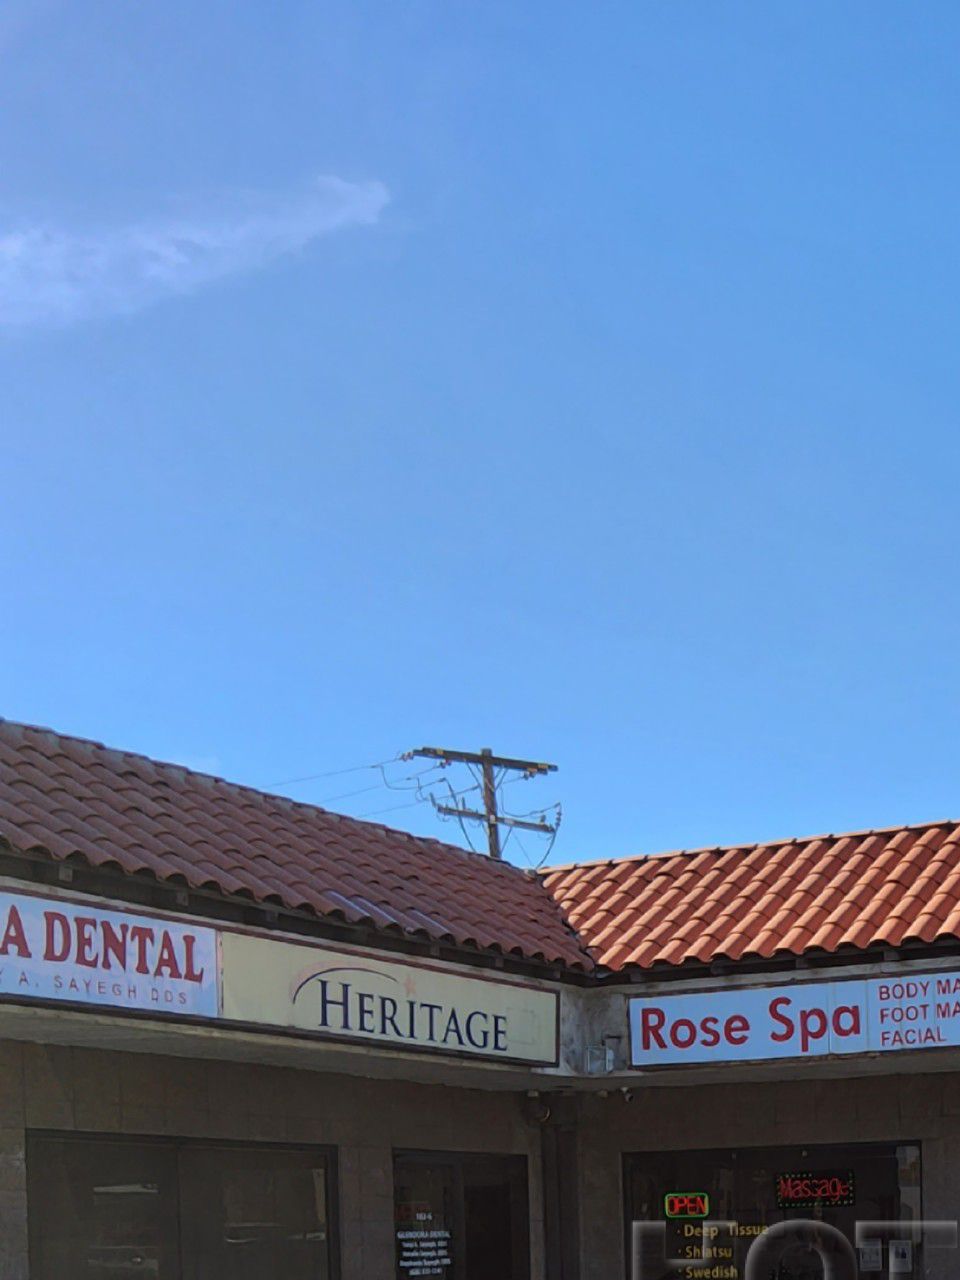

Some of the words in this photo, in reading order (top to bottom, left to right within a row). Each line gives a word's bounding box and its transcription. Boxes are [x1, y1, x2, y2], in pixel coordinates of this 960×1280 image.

[44, 910, 205, 984] DENTAL
[54, 975, 138, 999] SAYEGH
[878, 981, 930, 1002] BODY
[317, 979, 508, 1052] HERITAGE
[641, 1006, 750, 1051] Rose
[769, 996, 861, 1052] Spa
[879, 1004, 930, 1024] FOOT
[881, 1026, 947, 1046] FACIAL
[668, 1195, 707, 1216] OPEN
[684, 1223, 719, 1240] Deep
[727, 1222, 770, 1237] Tissue
[685, 1244, 733, 1259] Shiatsu
[685, 1265, 739, 1280] Swedish
